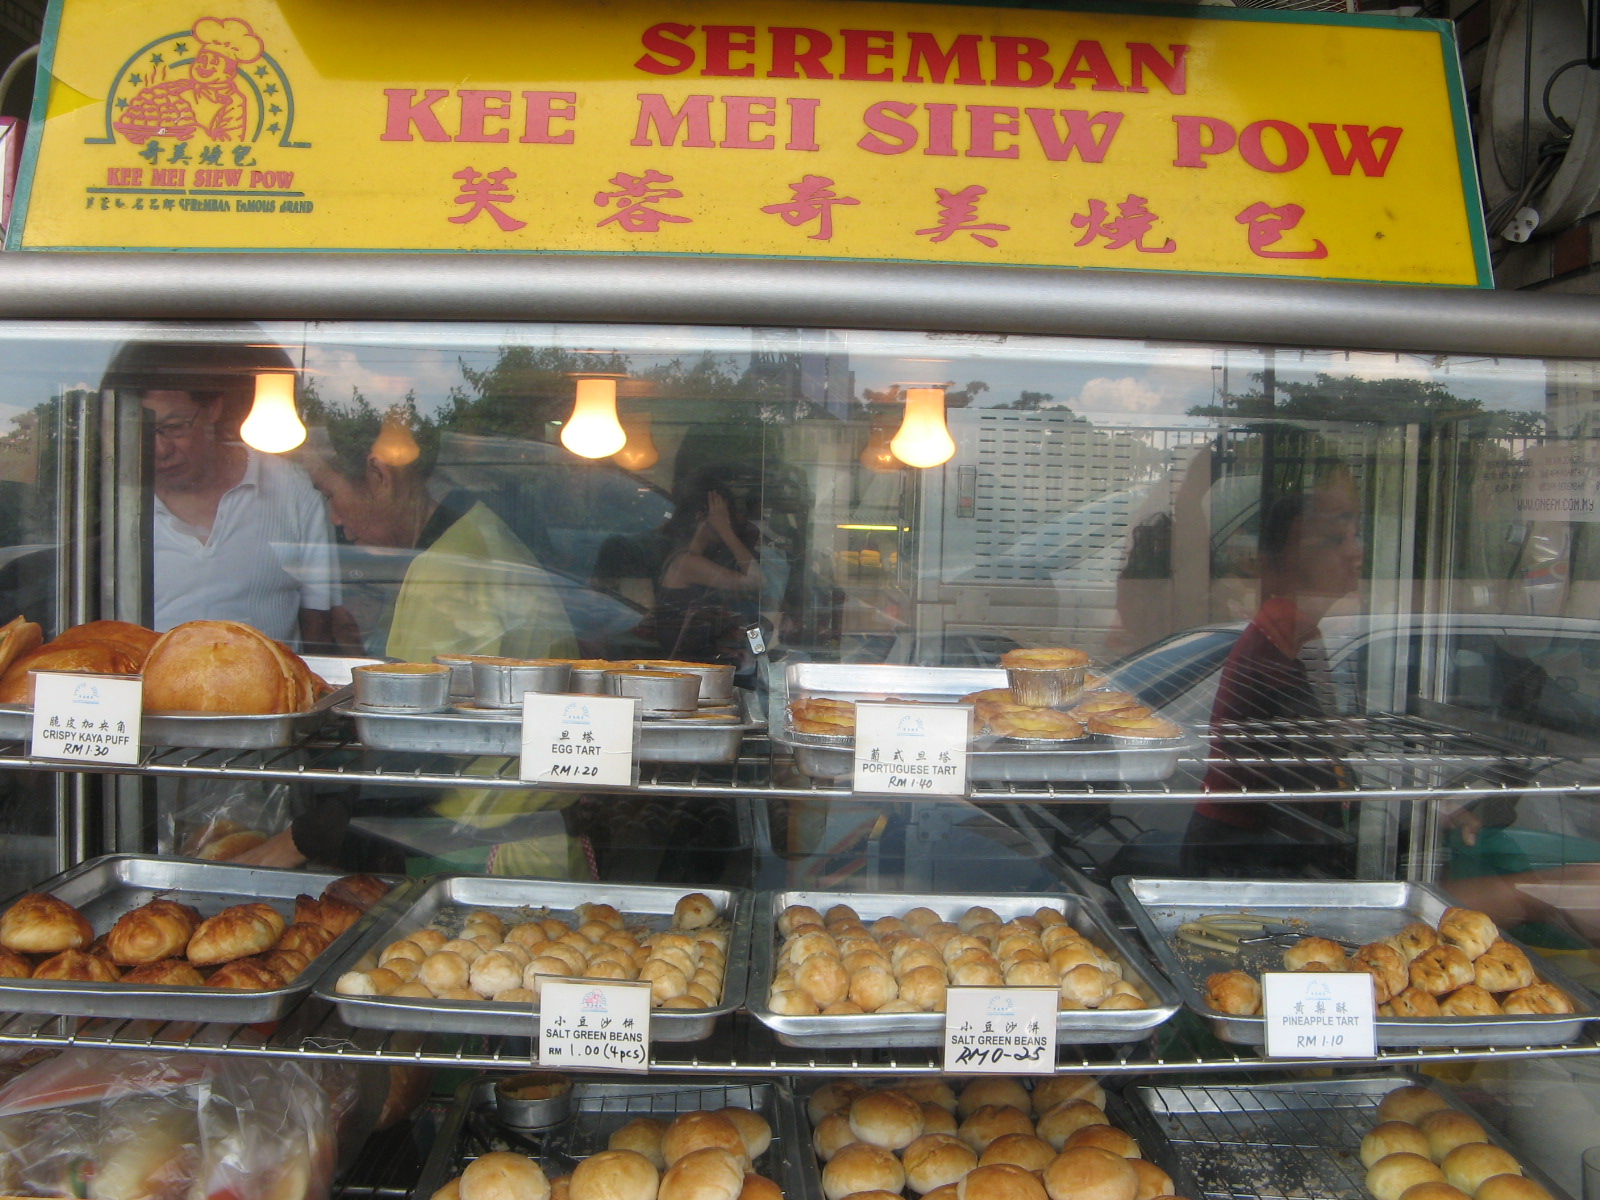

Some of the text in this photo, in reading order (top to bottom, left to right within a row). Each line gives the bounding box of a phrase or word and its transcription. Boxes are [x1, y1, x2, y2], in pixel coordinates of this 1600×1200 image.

[633, 22, 1190, 95] SEREMBAN
[380, 88, 1405, 178] KEE MEI SIEW POW
[107, 168, 295, 189] KEE MEI SIEW POW
[43, 729, 130, 745] CRISPY KAYA PUFF
[552, 743, 601, 755] EGG TART
[862, 763, 957, 775] PORTUGUESE TART
[1282, 1016, 1359, 1026] PINEAPPLE TART
[546, 1028, 643, 1042] SALT GREEN BEANS
[951, 1035, 1047, 1046] SALT GREEN BEANS
[548, 1047, 562, 1055] RM
[603, 1042, 646, 1064] (4pcs)
